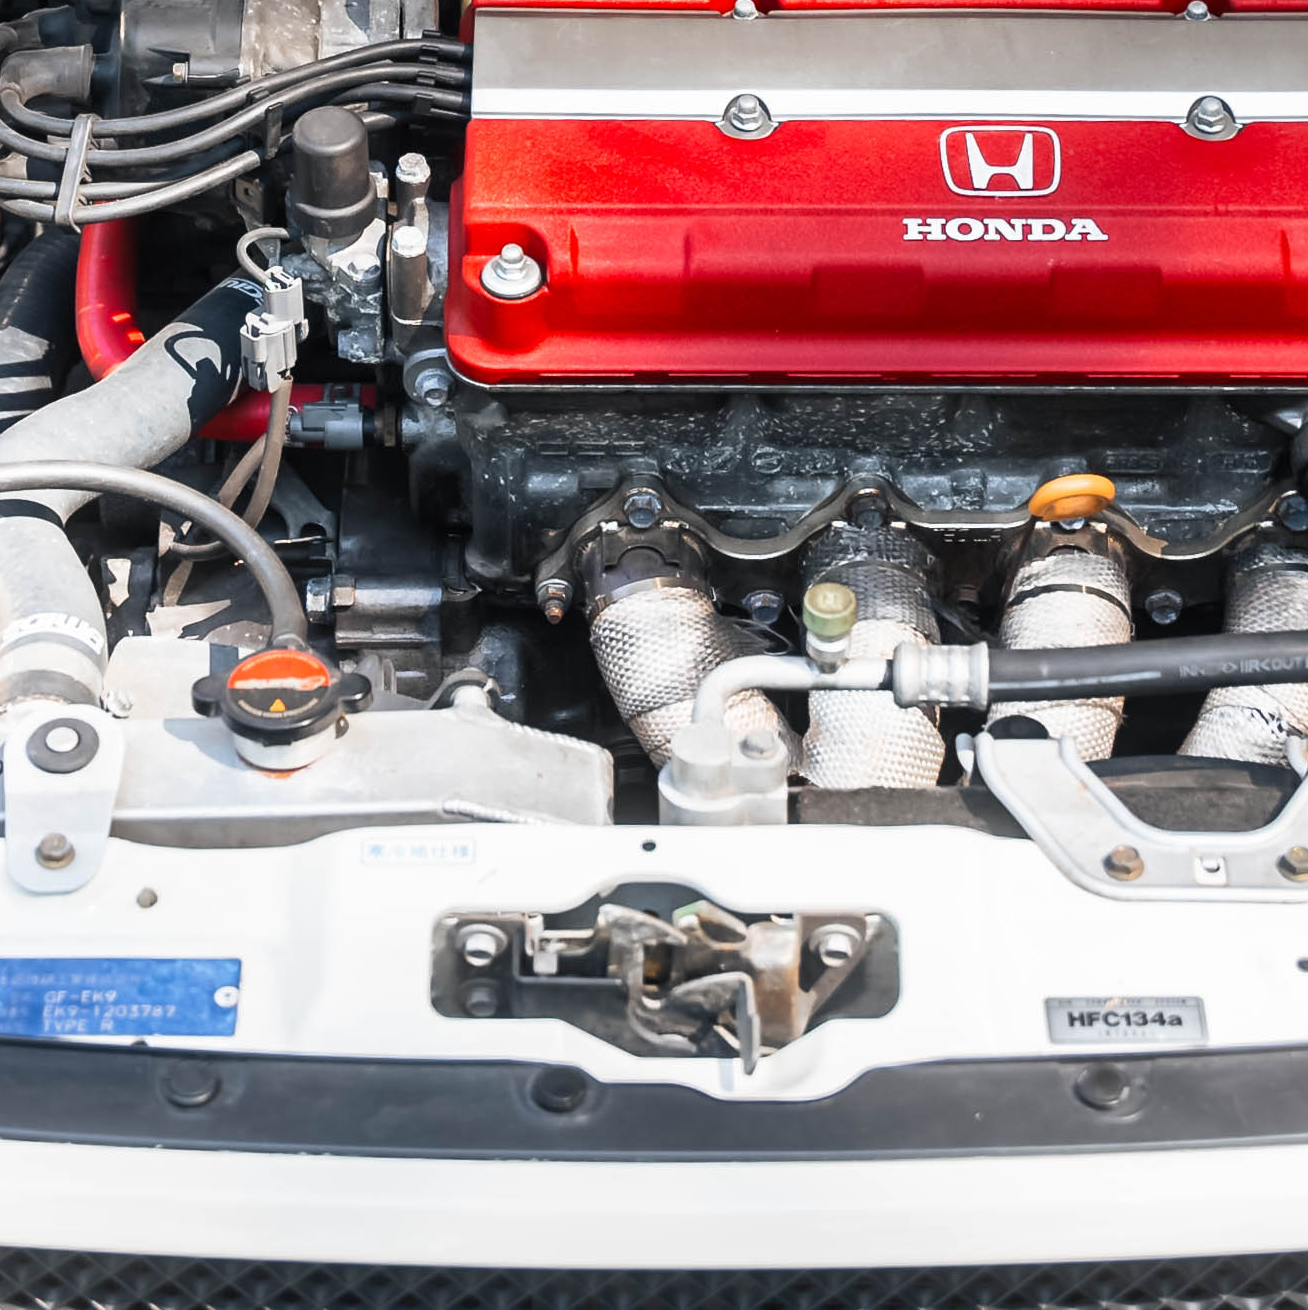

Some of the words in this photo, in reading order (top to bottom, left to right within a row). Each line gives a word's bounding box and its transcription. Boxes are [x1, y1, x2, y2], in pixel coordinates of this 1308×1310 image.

[902, 217, 1109, 243] HONDA
[43, 989, 118, 1004] GF-EK9
[42, 1018, 88, 1032] TYPE
[100, 1018, 115, 1032] R
[1066, 1010, 1184, 1029] HFC134a
